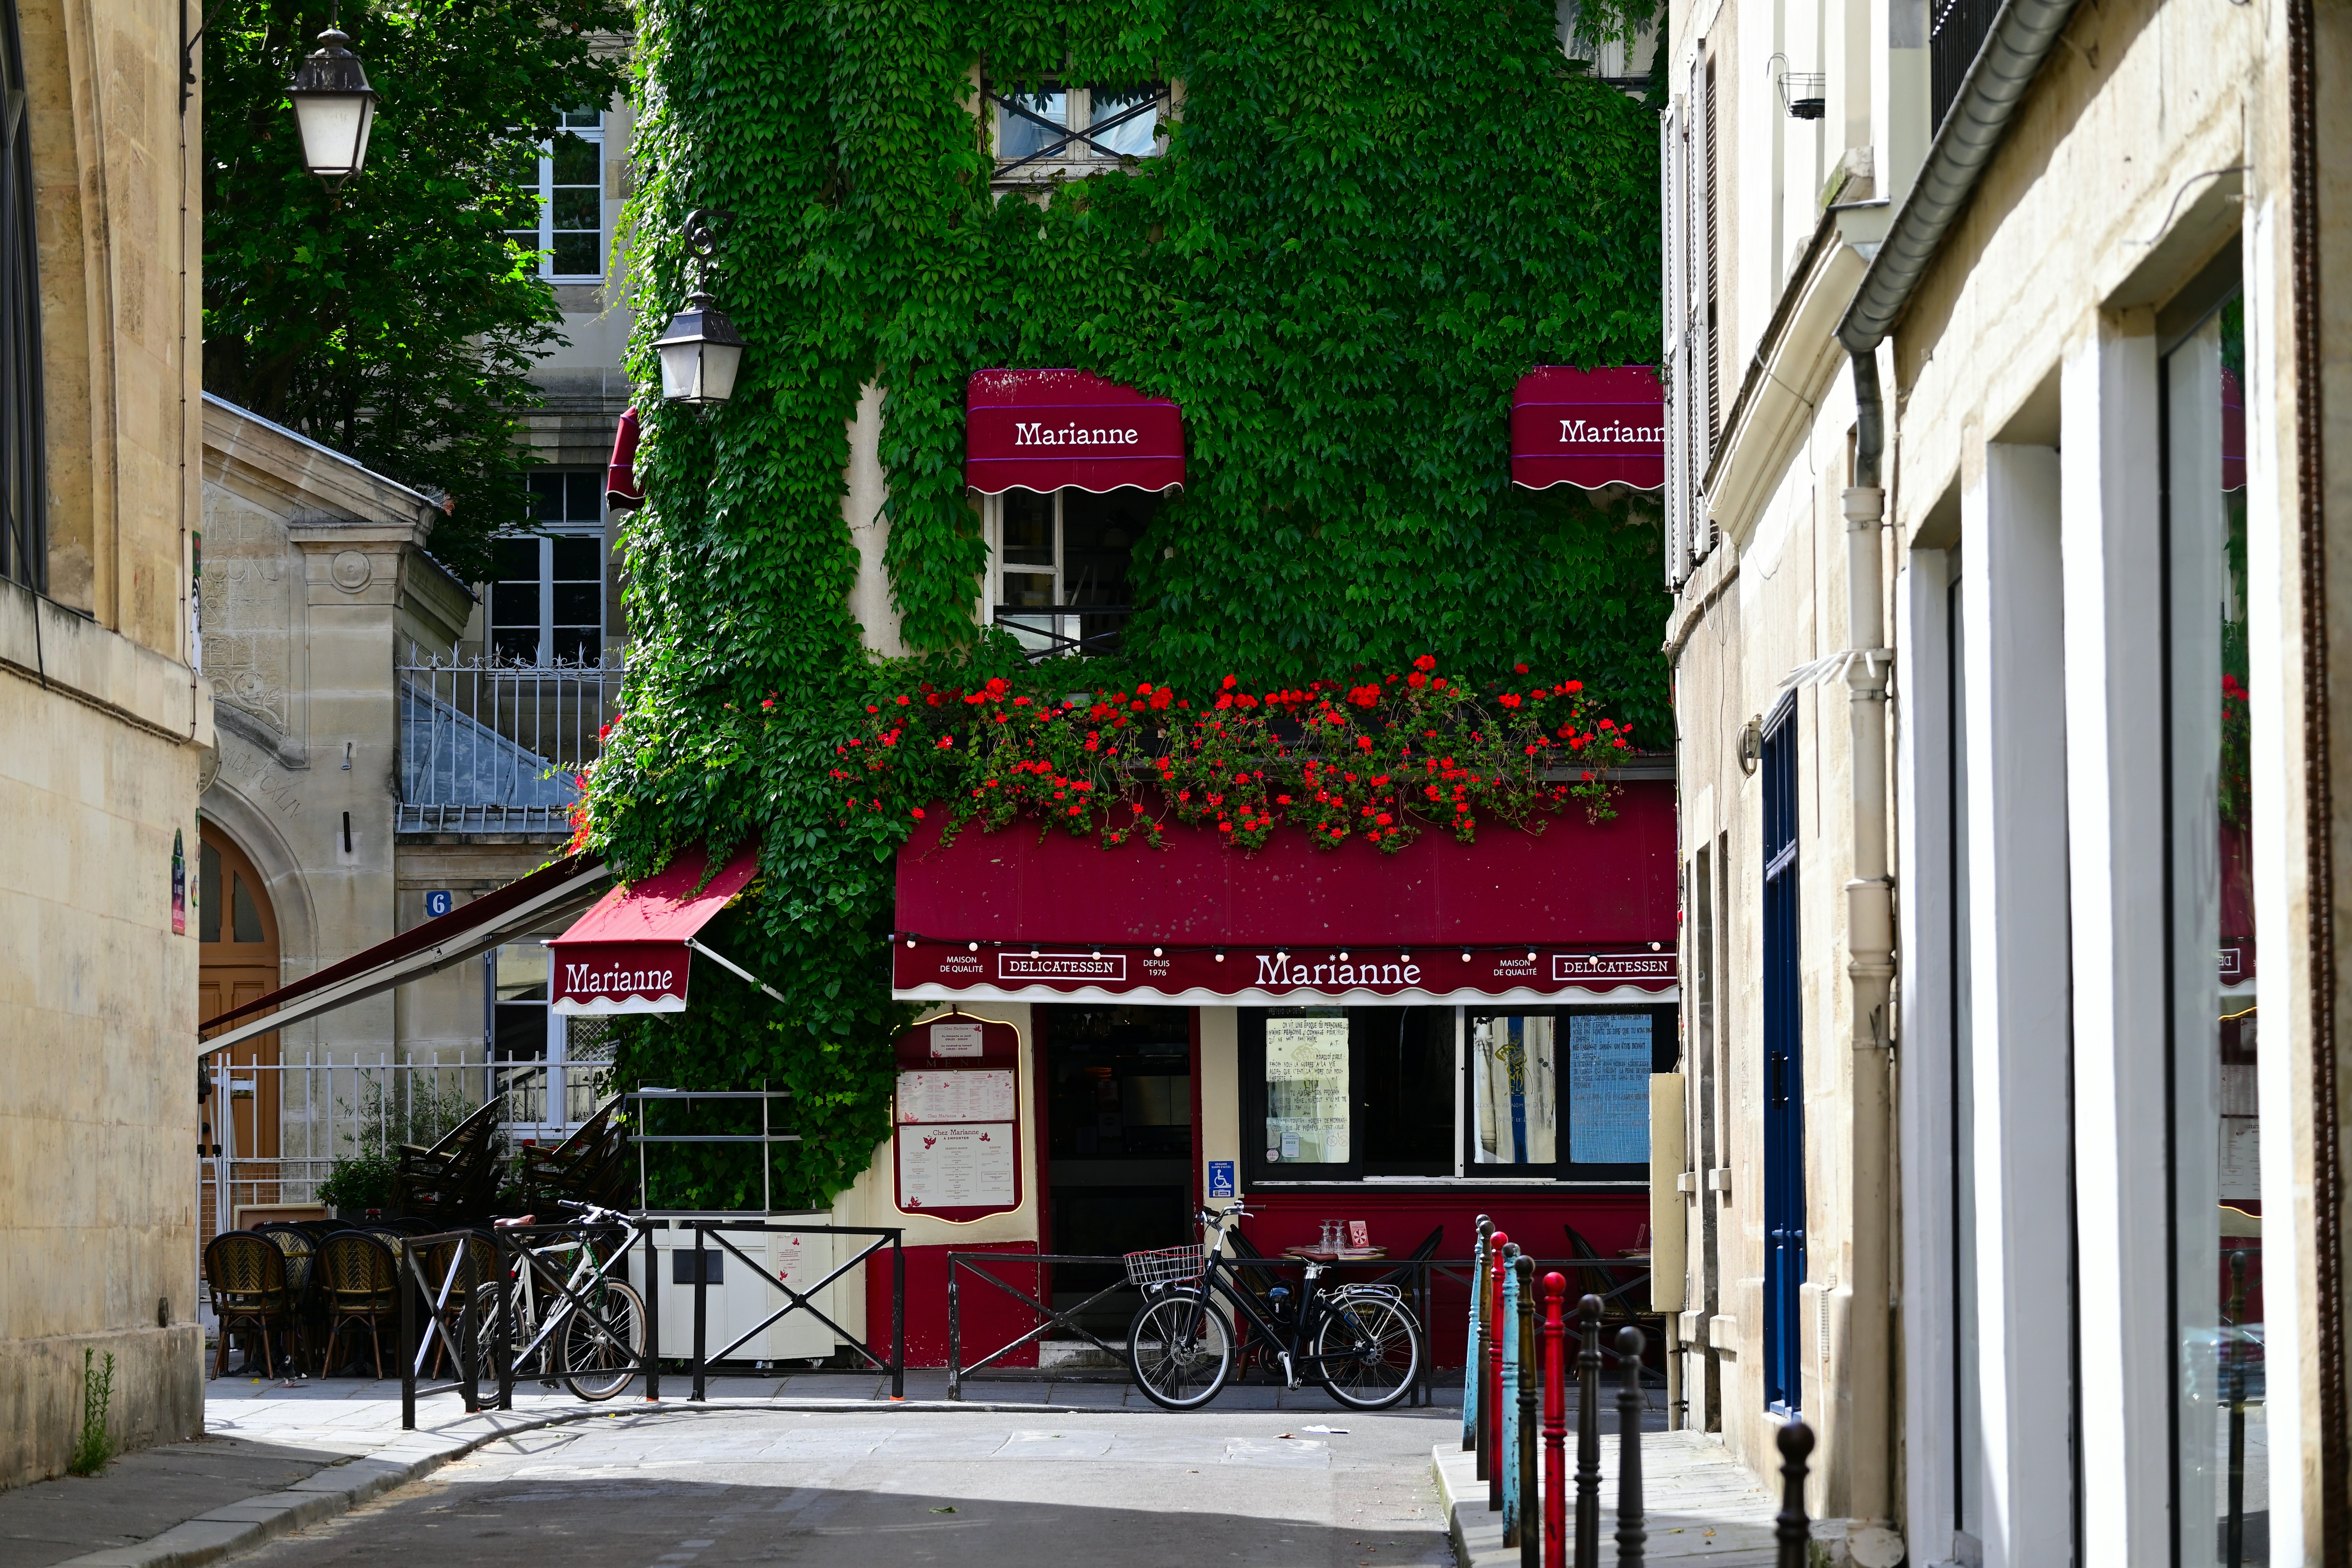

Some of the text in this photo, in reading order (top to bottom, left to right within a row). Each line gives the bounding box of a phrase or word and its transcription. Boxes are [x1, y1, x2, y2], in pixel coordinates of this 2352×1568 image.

[1015, 422, 1138, 445] Marianne
[433, 894, 445, 913] 6
[952, 964, 983, 973] QUALITÉ
[1010, 960, 1114, 973] DELICATESSEN
[1143, 959, 1170, 967] DEPUIS
[1564, 961, 1669, 973] DELICATESSEN
[1255, 954, 1421, 985] Marianne
[1505, 967, 1537, 976] QUALITÉ
[565, 962, 673, 993] Marianne
[926, 1058, 985, 1068] MENU
